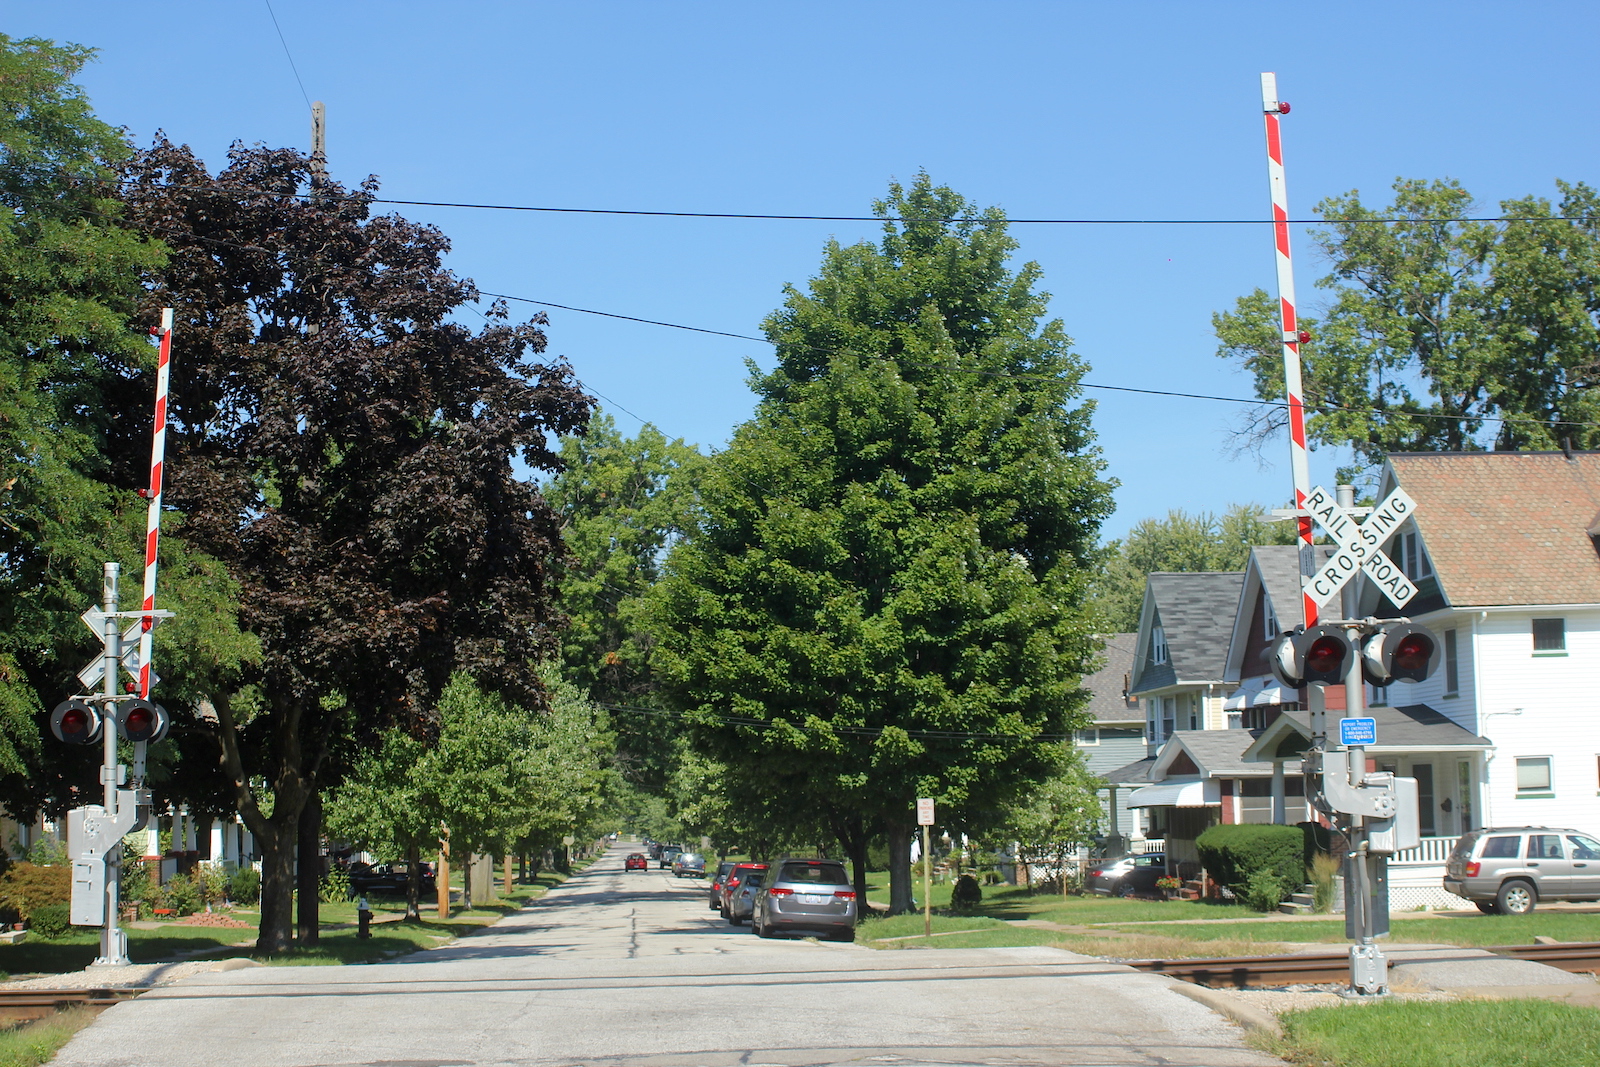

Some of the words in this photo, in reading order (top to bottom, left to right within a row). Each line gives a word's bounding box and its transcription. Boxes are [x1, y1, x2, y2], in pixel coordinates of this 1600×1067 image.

[1307, 491, 1347, 539] RAIL
[1366, 553, 1410, 601] ROAD
[1314, 498, 1406, 596] CROSSING
